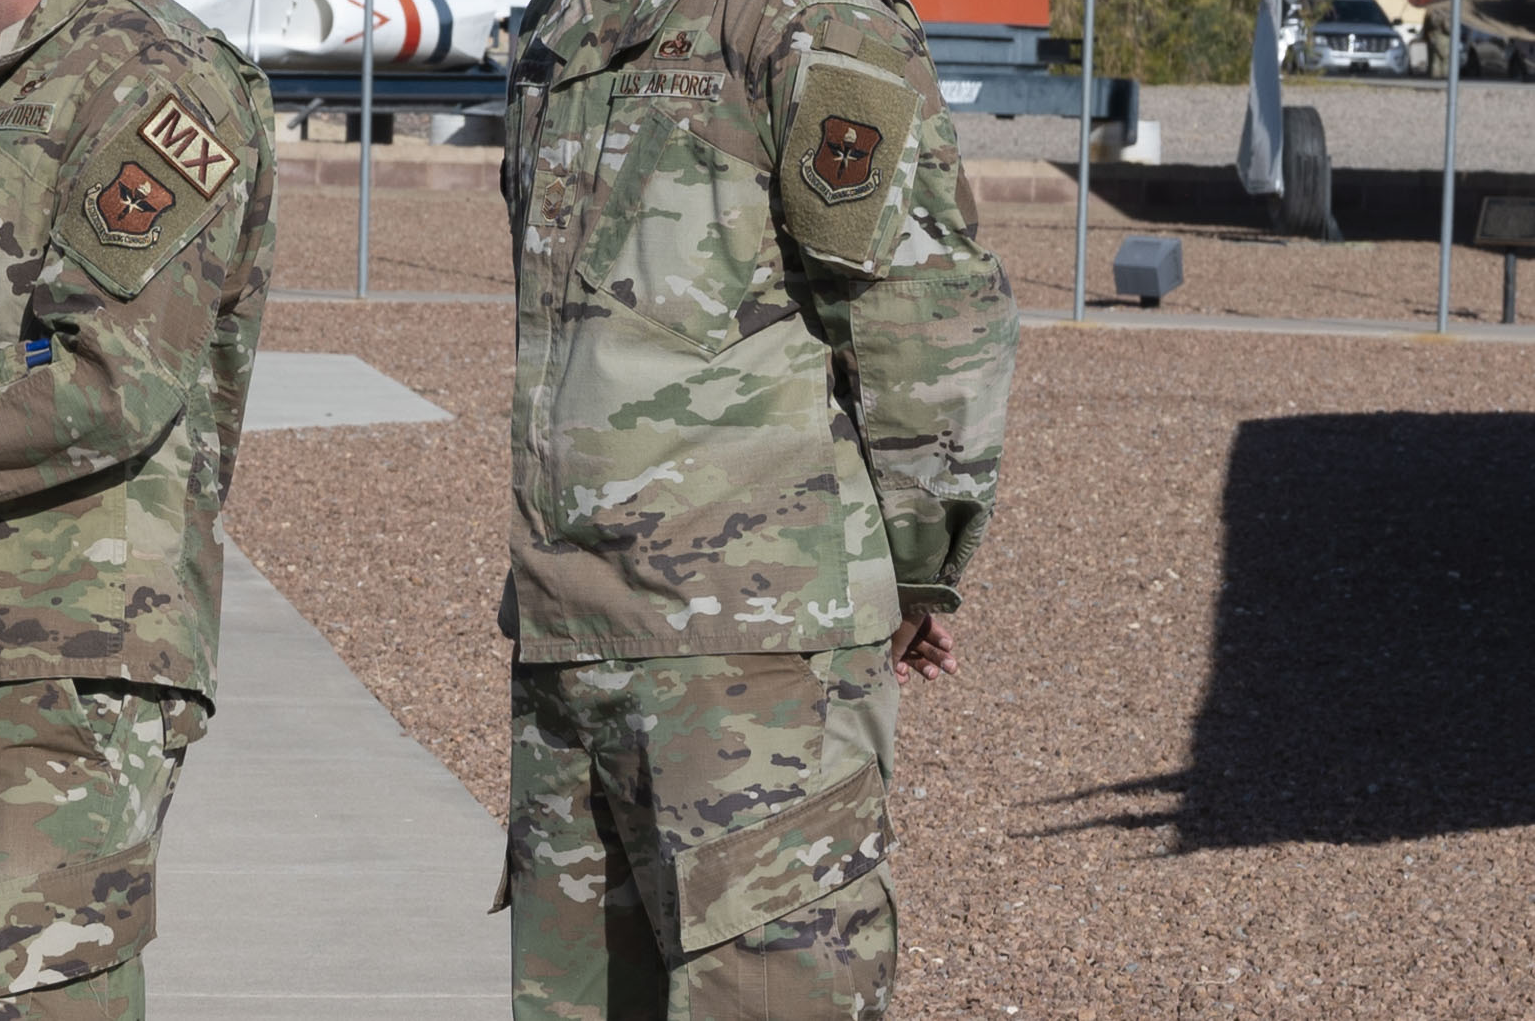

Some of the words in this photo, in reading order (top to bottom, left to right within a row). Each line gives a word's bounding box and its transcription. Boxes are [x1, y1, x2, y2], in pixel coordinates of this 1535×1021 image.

[644, 73, 667, 94] AIR
[670, 73, 715, 96] FORCE
[6, 105, 51, 127] FORCE
[151, 107, 227, 186] MX
